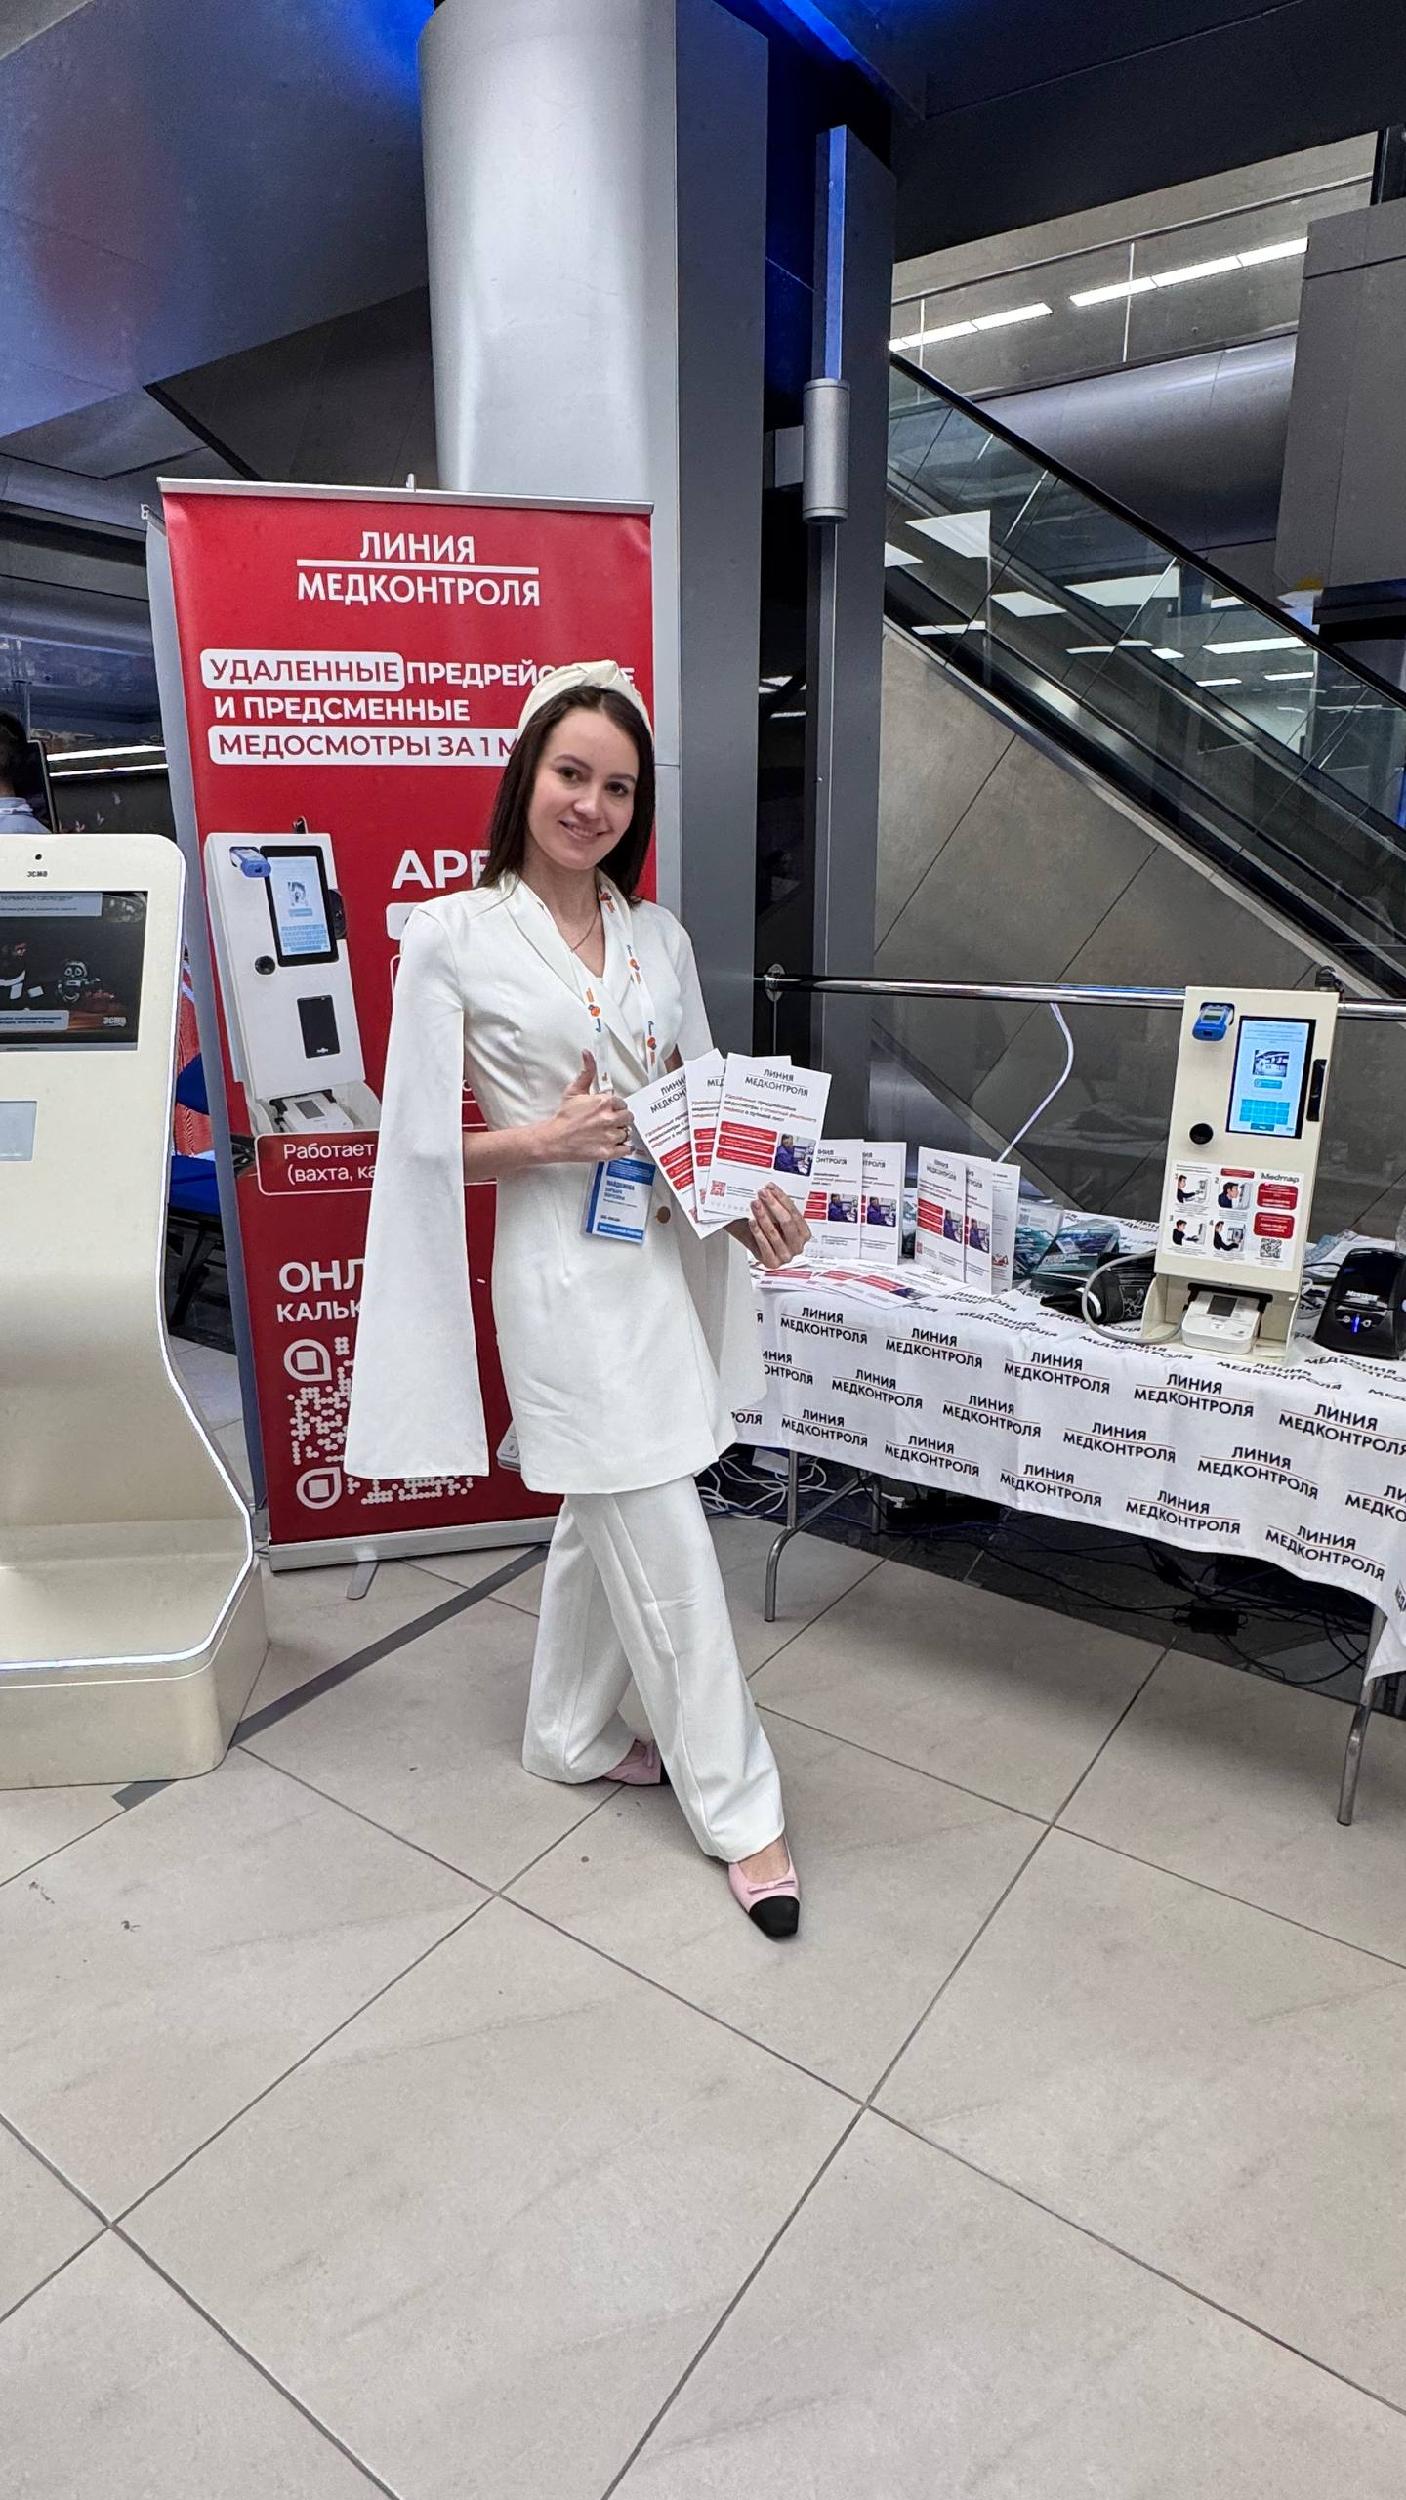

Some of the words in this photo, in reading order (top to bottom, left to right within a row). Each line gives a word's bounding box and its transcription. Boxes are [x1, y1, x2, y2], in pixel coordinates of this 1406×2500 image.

[360, 531, 476, 565] ЛИНИЯ
[297, 573, 540, 607] МЕДКОНТРОЛЯ
[209, 658, 399, 684] УДАЛЕННЫЕ
[214, 698, 235, 718] И
[244, 697, 470, 724] ПРЕДСМЕННЫЕ
[219, 734, 430, 759] МЕДОСМОТРЫ
[439, 736, 475, 756] ЗА
[481, 736, 490, 756] 1
[745, 1077, 809, 1096] МЕДКОНТРОЛЯ
[763, 1069, 794, 1082] ЛИНИЯ
[283, 1143, 375, 1160] Работает
[287, 1164, 353, 1185] (вахта,
[802, 1307, 844, 1324] ЛИНИЯ
[780, 1317, 868, 1345] МЕДКОНТРОЛЯ
[911, 1328, 958, 1347] ЛИНИЯ
[886, 1339, 982, 1369] МЕДКОНТРОЛЯ
[1031, 1352, 1083, 1371] ЛИНИЯ
[856, 1369, 896, 1390] ЛИНИЯ
[1004, 1363, 1110, 1395] МЕДКОНТРОЛЯ
[1166, 1374, 1222, 1395] ЛИНИЯ
[832, 1380, 923, 1409] МЕДКОНТРОЛЯ
[969, 1395, 1014, 1415] ЛИНИЯ
[1134, 1388, 1254, 1418] МЕДКОНТРОЛЯ
[802, 1409, 845, 1427] ЛИНИЯ
[943, 1404, 1042, 1438] МЕДКОНТРОЛЯ
[1314, 1403, 1378, 1431] ЛИНИЯ
[781, 1418, 868, 1447] МЕДКОНТРОЛЯ
[1092, 1422, 1147, 1441] ЛИНИЯ
[908, 1435, 954, 1454] ЛИНИЯ
[1063, 1432, 1176, 1464] МЕДКОНТРОЛЯ
[885, 1444, 979, 1477] МЕДКОНТРОЛЯ
[1231, 1446, 1292, 1470] ЛИНИЯ
[1023, 1464, 1074, 1484] ЛИНИЯ
[1197, 1460, 1318, 1500] МЕДКОНТРОЛЯ
[1000, 1473, 1102, 1507] МЕДКОНТРОЛЯ
[1157, 1490, 1210, 1515] ЛИНИЯ
[1126, 1501, 1241, 1535] МЕДКОНТРОЛЯ
[1297, 1525, 1356, 1550] ЛИНИЯ
[1265, 1530, 1385, 1581] МЕДКОНТРОЛЯ
